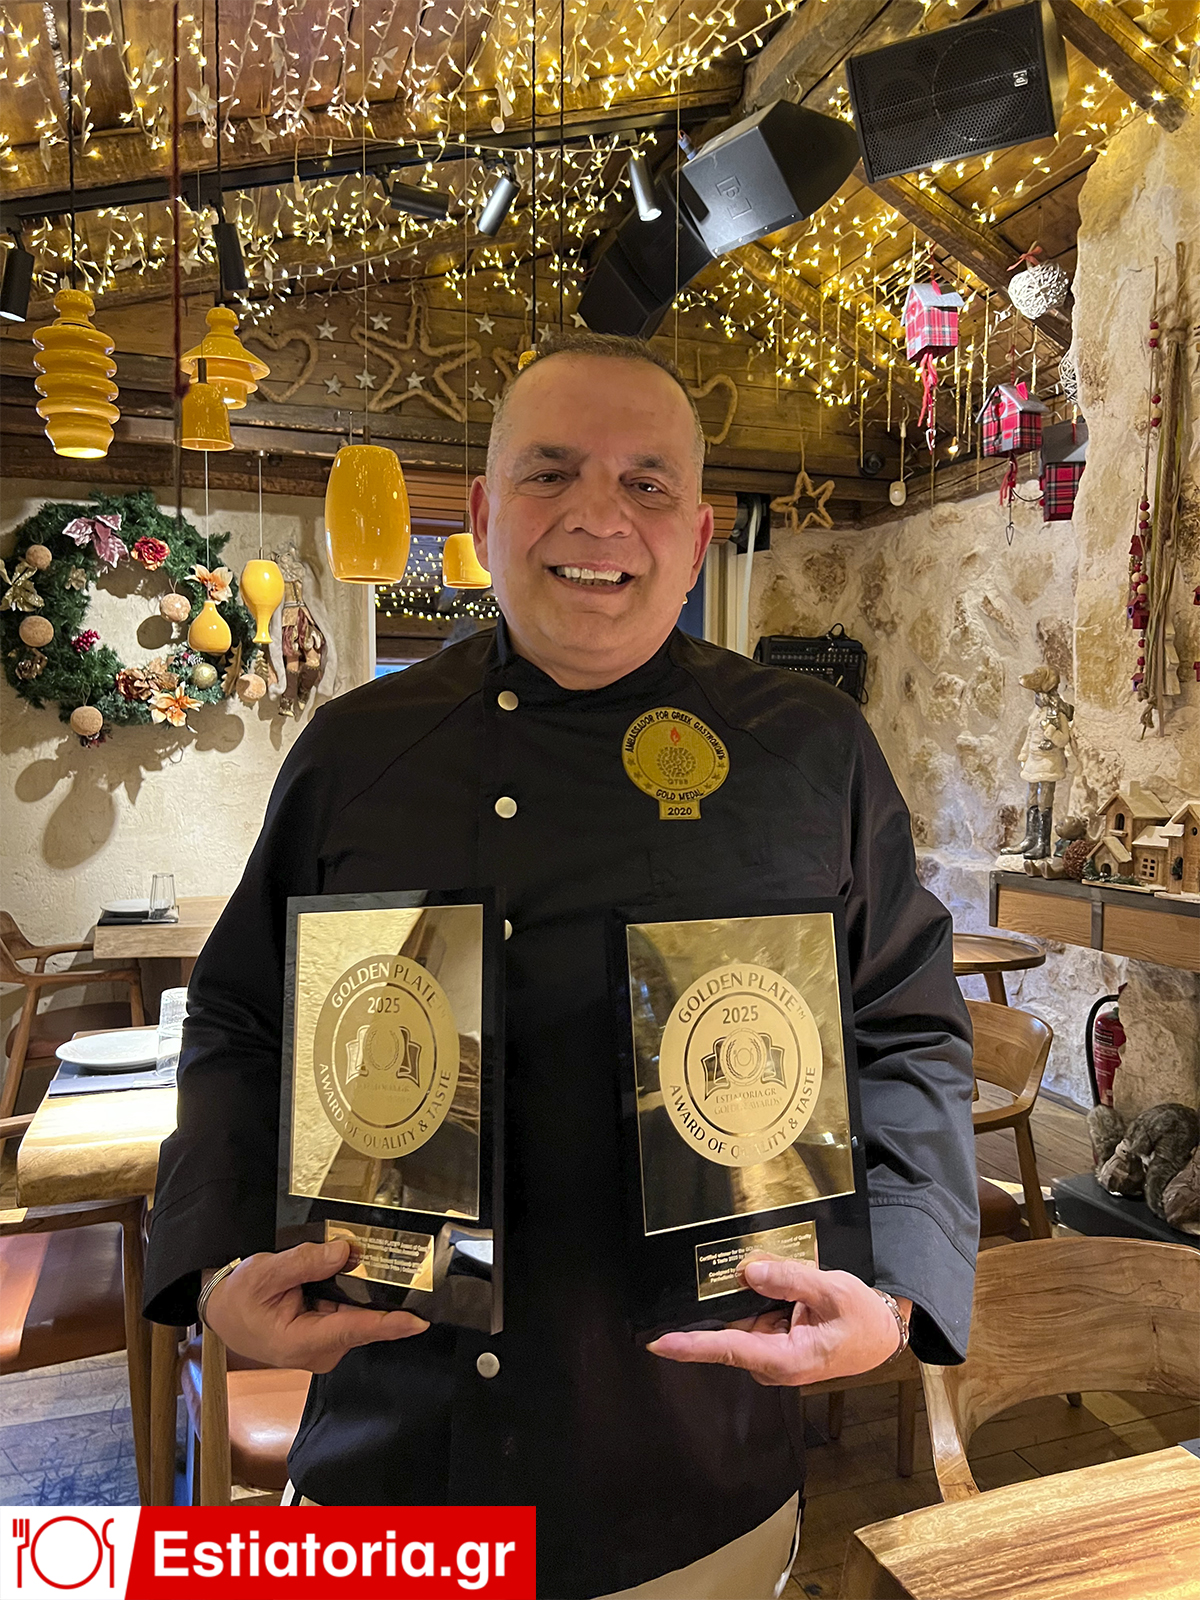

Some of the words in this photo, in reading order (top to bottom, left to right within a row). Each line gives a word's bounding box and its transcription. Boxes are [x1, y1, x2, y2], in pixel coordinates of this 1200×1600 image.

[625, 714, 654, 753] AMBASSADOR
[655, 710, 669, 720] FOR
[671, 711, 693, 725] GREEK
[694, 721, 726, 760] GASTRONOMY
[656, 789, 676, 800] GOLD
[679, 789, 705, 801] MEDAL
[667, 807, 693, 815] 2020
[332, 962, 390, 1008] GOLDEN
[367, 996, 400, 1014] 2025
[678, 971, 743, 1023] GOLDEN
[722, 1005, 759, 1024] 2025
[319, 1063, 344, 1121] AWARD
[345, 1121, 358, 1138] OF
[363, 1128, 415, 1150] QUALITY
[418, 1119, 428, 1132] &
[427, 1069, 451, 1119] TASTE
[669, 1085, 706, 1141] AWARD
[708, 1138, 728, 1154] OF
[788, 1117, 799, 1130] &
[796, 1067, 816, 1115] TASTE
